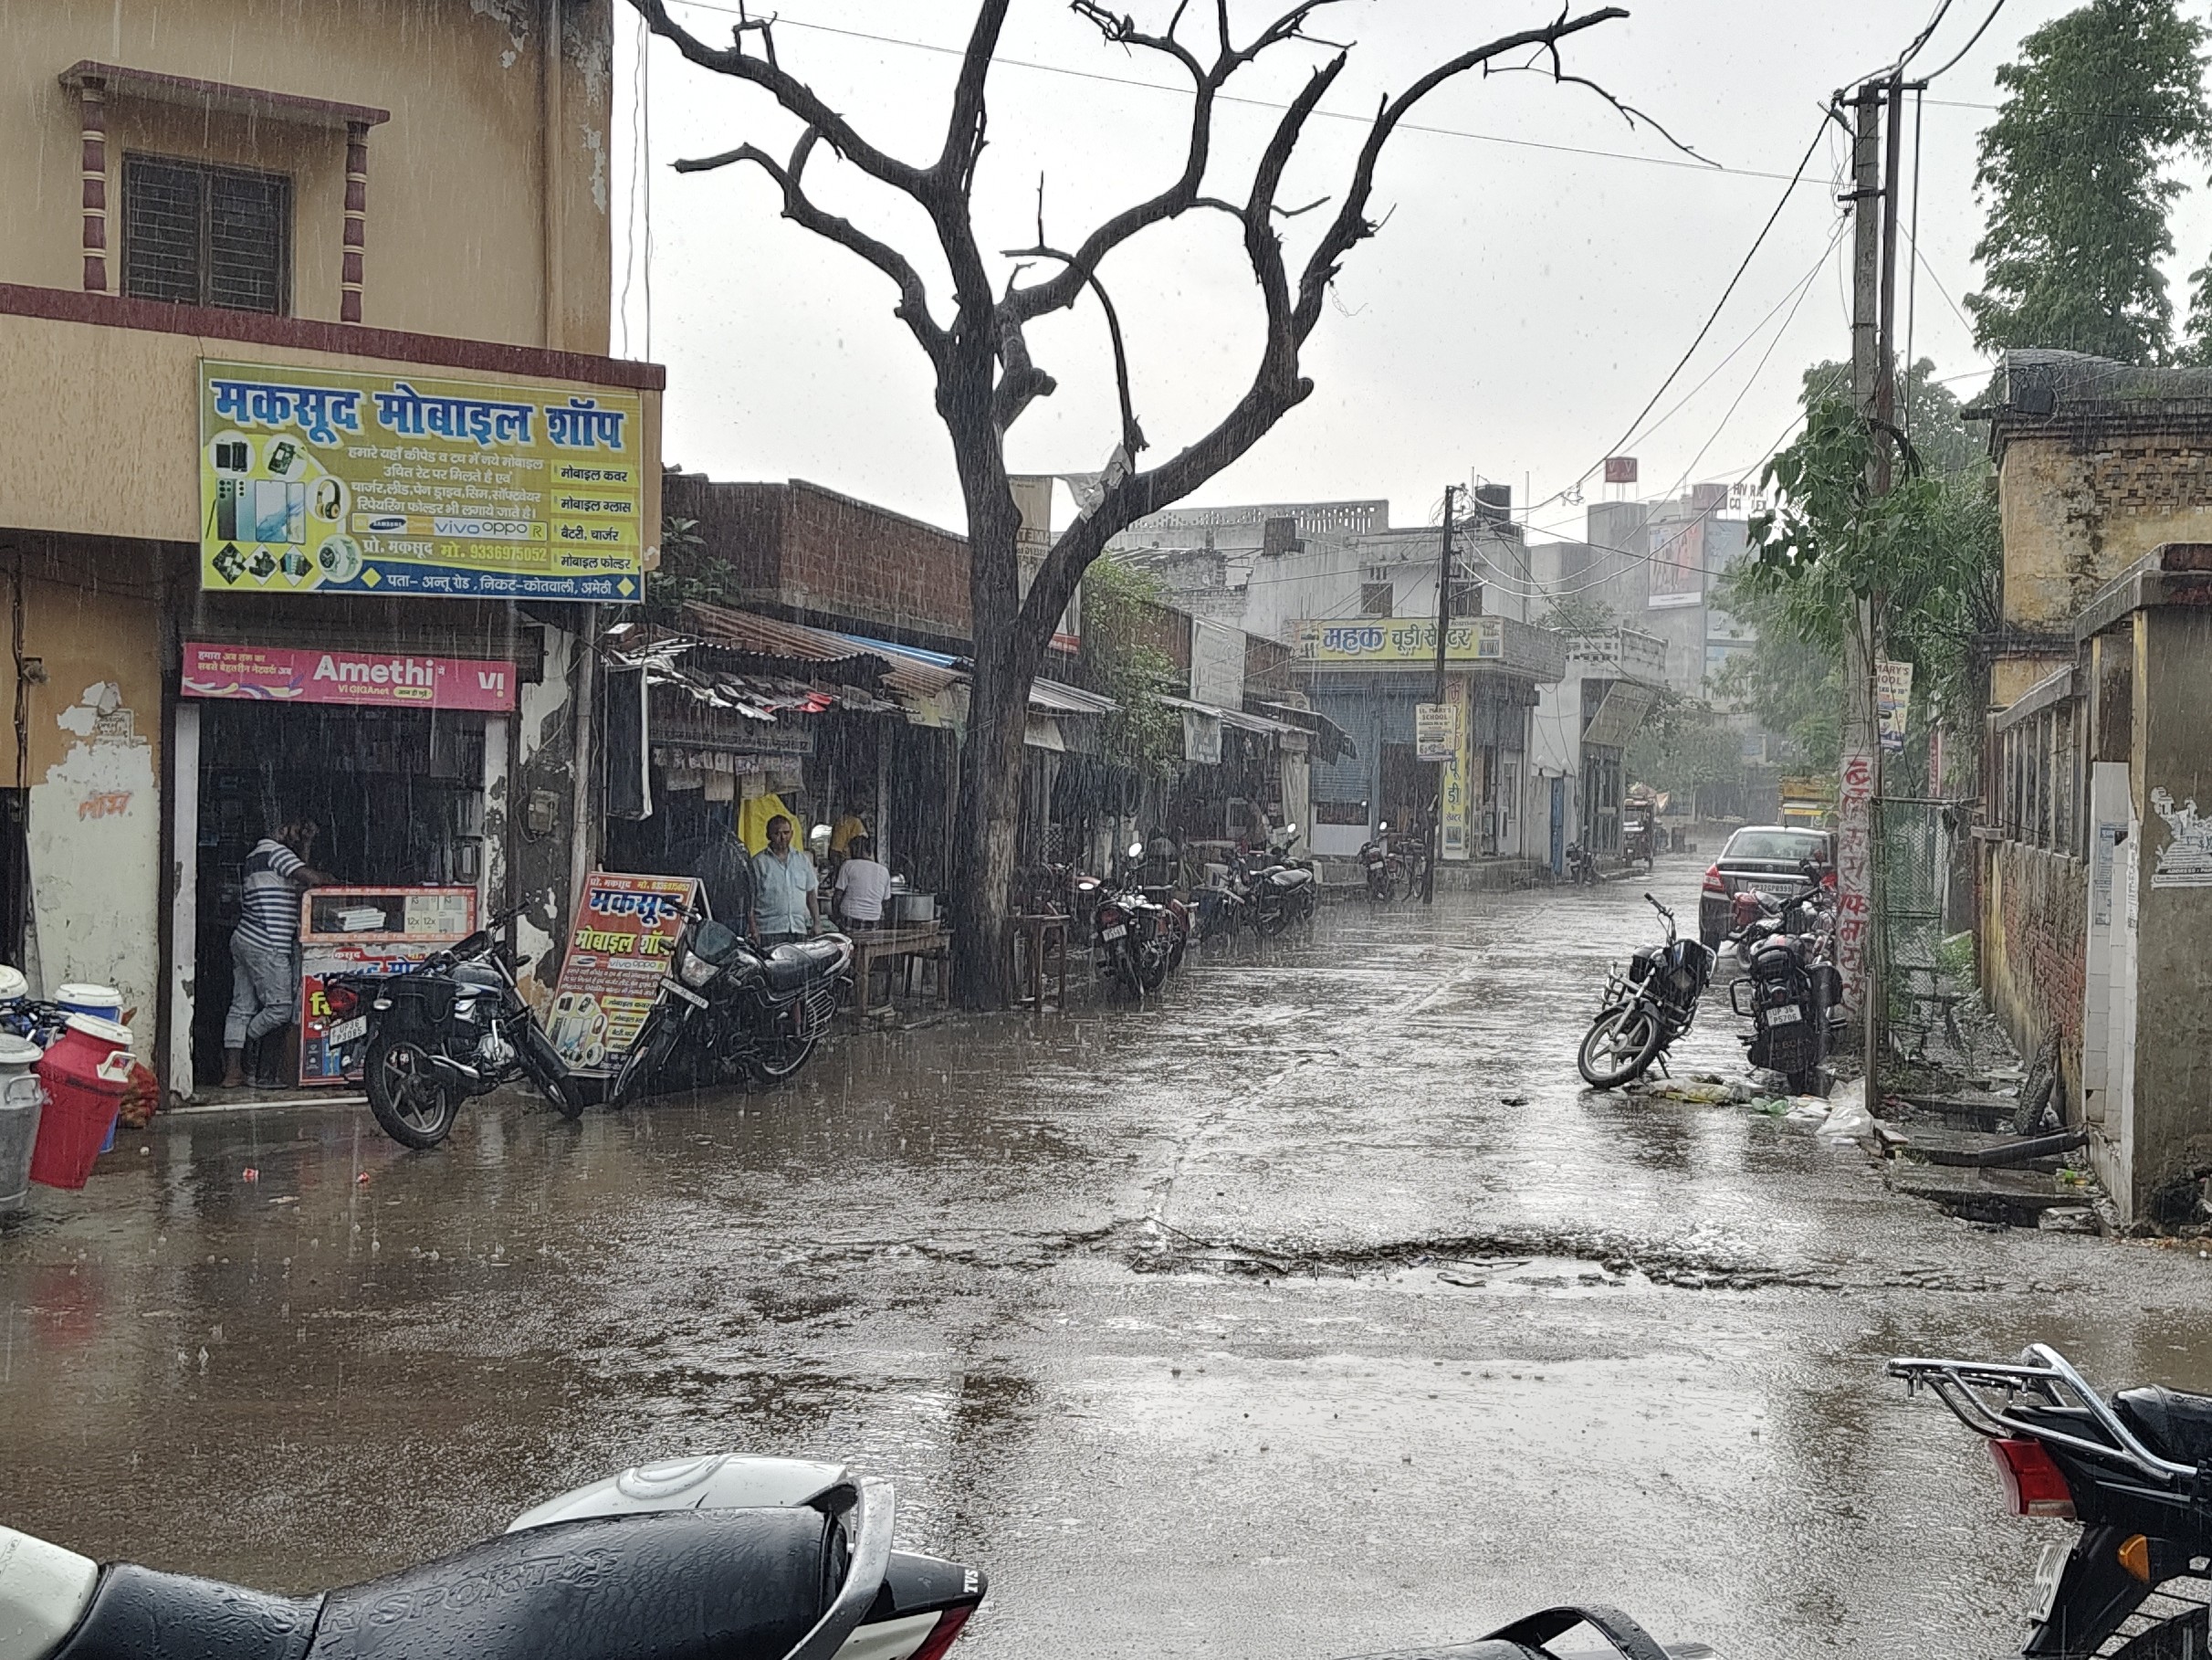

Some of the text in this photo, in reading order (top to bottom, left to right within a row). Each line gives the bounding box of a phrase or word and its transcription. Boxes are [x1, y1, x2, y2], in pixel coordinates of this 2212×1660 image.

[211, 381, 624, 448] मकसूद मोबाइल शॉप
[348, 444, 377, 458] हमारे
[468, 451, 480, 465] में
[480, 453, 499, 467] नये
[501, 453, 544, 470] मोबाइल
[383, 462, 413, 478] उचित
[415, 465, 431, 478] रेट
[432, 469, 447, 480] पर
[449, 466, 482, 483] मिलते
[561, 464, 628, 483] मोबाइल कवर
[407, 499, 444, 515] फोल्डर
[445, 499, 459, 515] भी
[462, 501, 494, 517] लगाये
[496, 503, 520, 519] जाते
[561, 495, 632, 513] मोबाइल ग्लास
[435, 520, 480, 535] vivo
[481, 520, 529, 536] oppo
[591, 526, 620, 541] चार्जर
[362, 537, 548, 562] प्रो. मकसूद मो. 9336975052
[561, 552, 632, 570] मोबाइल फोल्डर
[581, 578, 613, 594] अमेठी
[1322, 625, 1386, 652] महक
[312, 654, 435, 686] Amethi
[575, 925, 638, 954] मोबाइल
[609, 959, 632, 969] vivo
[339, 1019, 361, 1033] UP36
[963, 1569, 979, 1593] TVS
